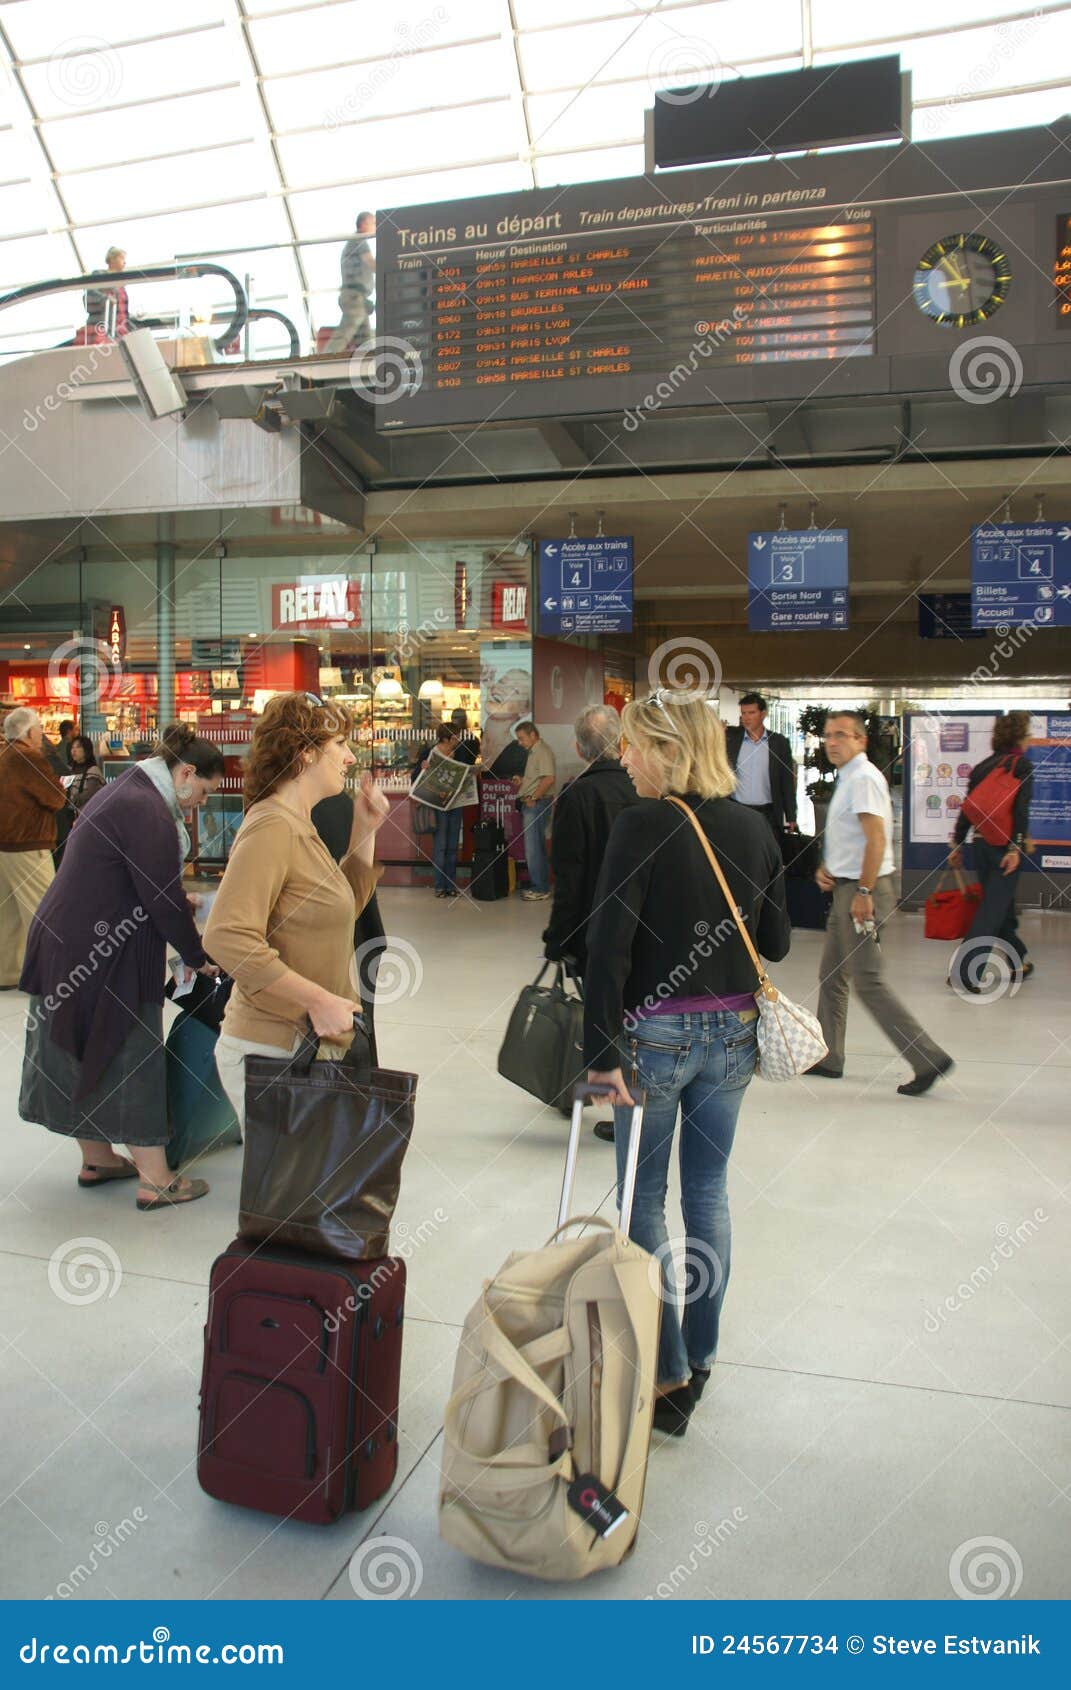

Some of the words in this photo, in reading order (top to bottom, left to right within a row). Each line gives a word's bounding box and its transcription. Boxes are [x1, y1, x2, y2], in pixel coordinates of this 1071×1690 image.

[579, 209, 615, 225] Train
[617, 202, 696, 221] departures
[703, 192, 742, 211] Treni
[744, 192, 758, 205] in
[759, 187, 827, 209] partenza
[845, 208, 871, 221] Voie
[397, 227, 457, 247] Trains
[464, 223, 488, 239] au
[496, 211, 562, 236] départ
[695, 219, 768, 236] Particularités
[476, 249, 506, 261] Heure
[510, 241, 568, 256] Destination
[397, 258, 423, 270] Train
[562, 268, 594, 280] ARLES
[586, 282, 612, 294] AUTO
[510, 303, 565, 317] BRUXELLES
[510, 320, 541, 333] PARIS
[510, 337, 541, 350] PARIS
[510, 350, 565, 365] MARSEILLE
[569, 350, 582, 361] ST
[587, 346, 631, 359] CHARLES
[510, 366, 565, 381] MARSEILLE
[569, 366, 582, 377] ST
[587, 361, 631, 375] CHARLES
[976, 528, 1005, 538] Accès
[1006, 528, 1024, 537] aux
[1025, 526, 1054, 536] trains
[771, 535, 798, 545] Accès
[799, 536, 816, 545] aux
[816, 533, 844, 543] trains
[560, 542, 586, 552] Accès
[587, 543, 603, 551] aux
[604, 540, 629, 550] trains
[782, 564, 793, 580] 3
[1029, 558, 1042, 574] 4
[570, 571, 582, 586] 4
[771, 591, 798, 600] Sortie
[799, 591, 822, 600] Nord
[975, 586, 1008, 596] Billets
[280, 579, 350, 624] RELAY
[502, 586, 528, 622] RELAY
[771, 612, 793, 621] Gare
[794, 611, 829, 621] routière
[976, 606, 1015, 617] Accueil
[111, 609, 121, 665] TABAC
[482, 783, 512, 793] Petite
